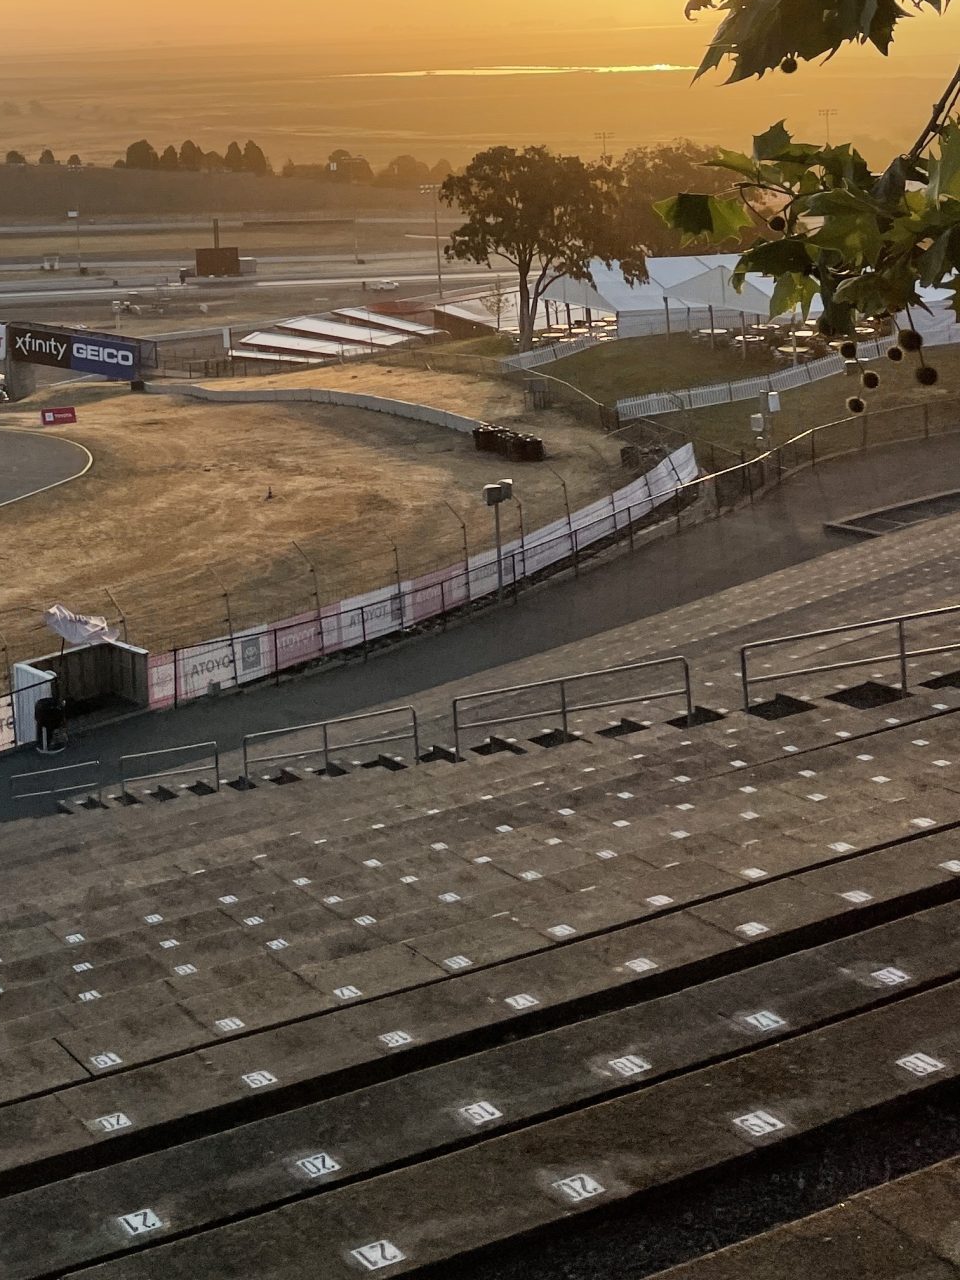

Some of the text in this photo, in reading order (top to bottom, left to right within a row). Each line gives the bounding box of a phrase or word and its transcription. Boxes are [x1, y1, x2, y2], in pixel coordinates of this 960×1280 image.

[15, 333, 67, 360] xfinity
[72, 343, 134, 366] GEICO
[751, 1013, 780, 1028] 17
[94, 1053, 116, 1066] 19
[246, 1072, 272, 1085] 19
[99, 1114, 127, 1130] 20
[464, 1104, 496, 1121] 19
[740, 1114, 777, 1133] 19
[301, 1155, 335, 1175] 20
[557, 1176, 599, 1199] 20
[122, 1211, 156, 1232] 21
[355, 1243, 402, 1267] 21
